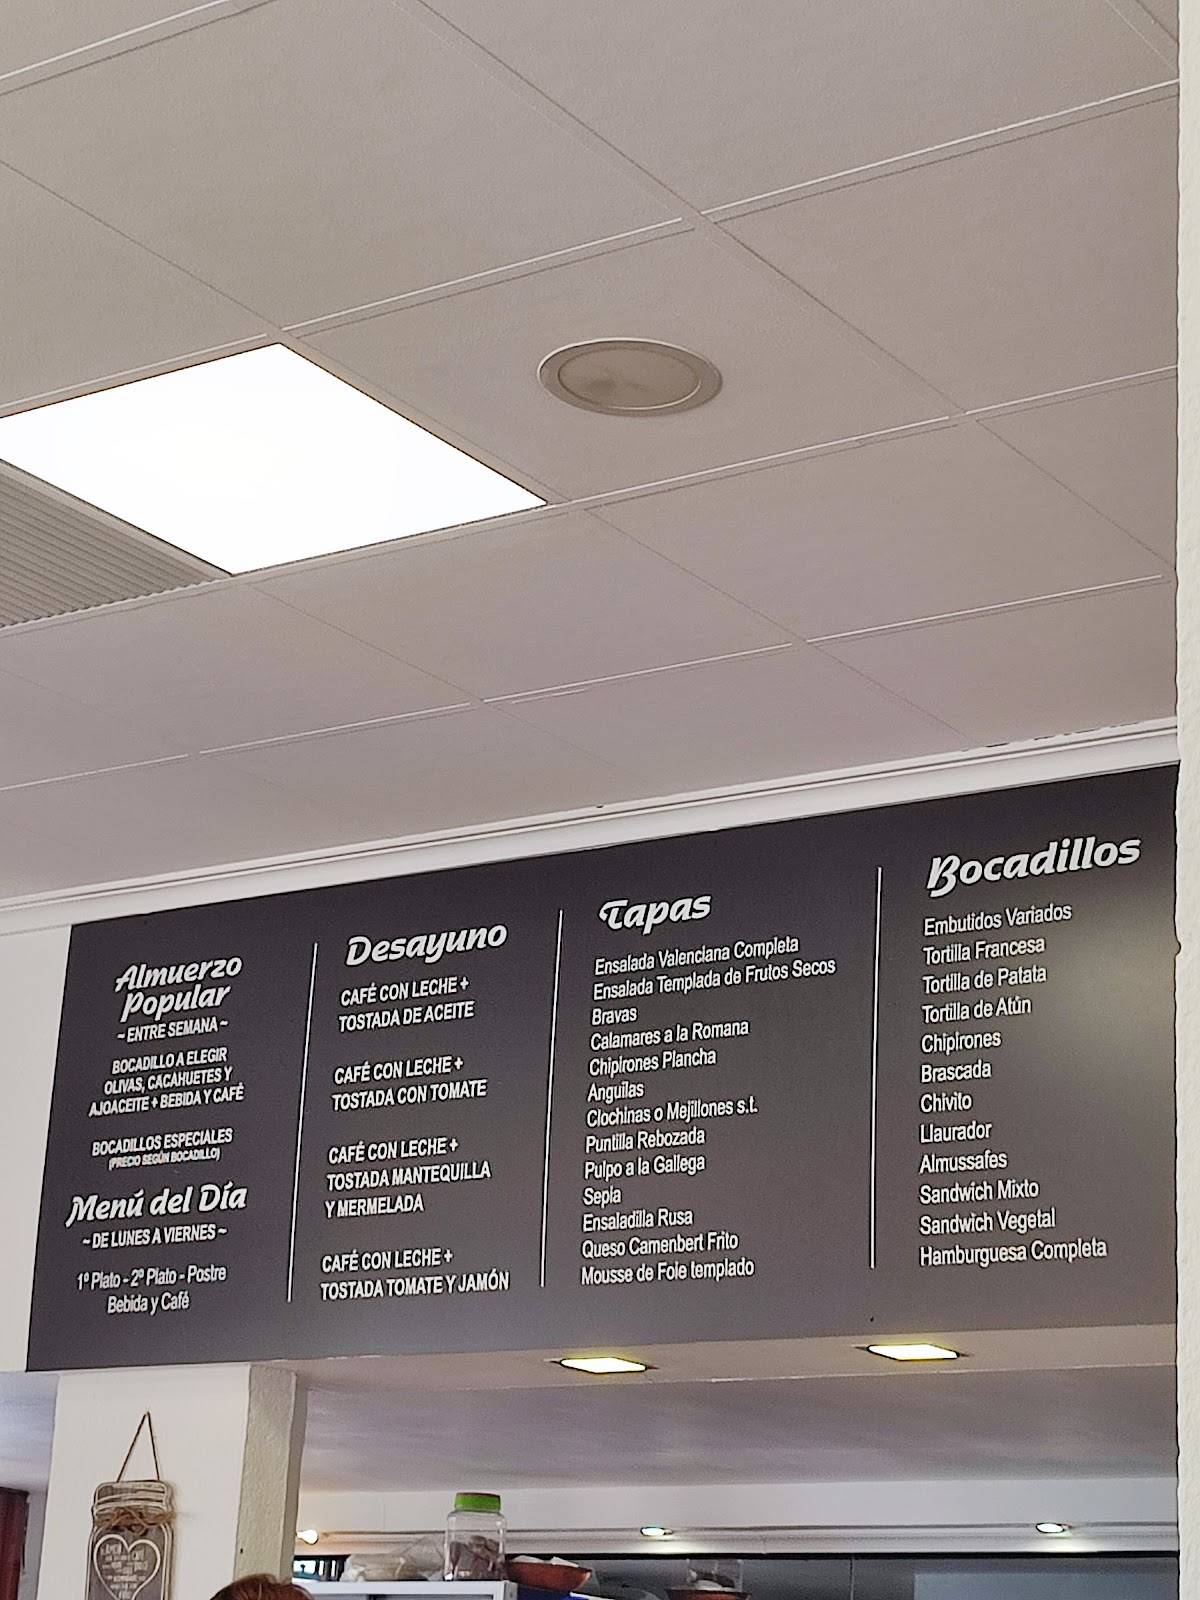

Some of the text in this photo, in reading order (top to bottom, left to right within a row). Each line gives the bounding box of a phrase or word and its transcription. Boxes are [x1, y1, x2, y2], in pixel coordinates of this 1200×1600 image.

[926, 836, 1141, 898] Bocadillos
[599, 895, 711, 934] Tapas
[924, 902, 1072, 937] Embutidos Variados
[346, 924, 507, 965] Desayuno
[595, 936, 799, 975] Ensalada Valenciana Completa
[924, 935, 1045, 965] Tortilla Francesa
[115, 957, 242, 992] Almuerzo
[594, 959, 836, 1000] Ensalada Templada de Frutos Secos
[923, 965, 1047, 994] Tortilla de Patata
[120, 984, 231, 1022] Popular
[341, 983, 376, 1007] CAFÉ
[380, 982, 409, 1001] CON
[412, 977, 458, 998] LECHE
[339, 1001, 475, 1032] TOSTADA DE ACEITE
[592, 1006, 637, 1025] Bravas
[922, 995, 1031, 1023] Tortilla de Atún
[591, 1020, 749, 1051] Calamares a la Romana
[921, 1030, 1001, 1056] Chipirones
[112, 1047, 227, 1074] BOCADILLO A ELEGIR
[335, 1063, 370, 1085] CAFÉ
[374, 1062, 403, 1081] CON
[406, 1056, 452, 1077] LECHE
[589, 1049, 716, 1078] Chipirones Plancha
[921, 1060, 991, 1084] Brascada
[104, 1066, 233, 1095] OLIVAS, CACAHUETES Y
[588, 1081, 644, 1103] Anguilas
[88, 1096, 150, 1117] AJOACEITE
[160, 1091, 201, 1108] BEBIDA
[203, 1089, 212, 1104] Y
[213, 1082, 244, 1103] CAFÉ
[332, 1079, 487, 1111] TOSTADA CON TOMATE
[921, 1093, 972, 1112] Chivito
[587, 1106, 651, 1128] Clochinas
[654, 1106, 664, 1122] o
[667, 1099, 733, 1122] Mejillones
[92, 1128, 233, 1156] BOCADILLOS ESPECIALES
[586, 1127, 705, 1153] Puntilla Rebozada
[920, 1121, 992, 1144] Llaurador
[171, 1148, 220, 1163] BOCADILLO)
[329, 1141, 365, 1164] CAFÉ
[368, 1141, 398, 1161] CON
[400, 1138, 447, 1158] LECHE
[919, 1150, 1008, 1174] Almussafes
[327, 1161, 490, 1191] TOSTADA MANTEQUILLA
[584, 1154, 705, 1182] Pulpo a la Gallega
[65, 1181, 247, 1227] Menú del Día
[325, 1194, 424, 1218] Y MERMELADA
[583, 1186, 621, 1208] Sepia
[920, 1180, 1039, 1205] Sandwich Mixto
[583, 1208, 693, 1232] Ensaladilla Rusa
[920, 1208, 1055, 1235] Sandwich Vegetal
[92, 1233, 109, 1248] DE
[111, 1229, 150, 1247] LUNES
[152, 1228, 161, 1244] A
[164, 1224, 216, 1243] VIERNES
[582, 1231, 739, 1259] Queso Camenbert Frito
[322, 1250, 359, 1273] CAFÉ
[362, 1251, 391, 1270] CON
[395, 1248, 441, 1267] LECHE
[920, 1238, 1107, 1268] Hamburguesa Completa
[91, 1271, 120, 1289] Plato
[146, 1268, 177, 1286] Plato
[188, 1264, 226, 1283] Postre
[321, 1270, 509, 1300] TOSTADA TOMATE Y JAMÓN
[582, 1257, 754, 1285] Mousse de Foie templado
[108, 1291, 189, 1315] Bebida y Café
